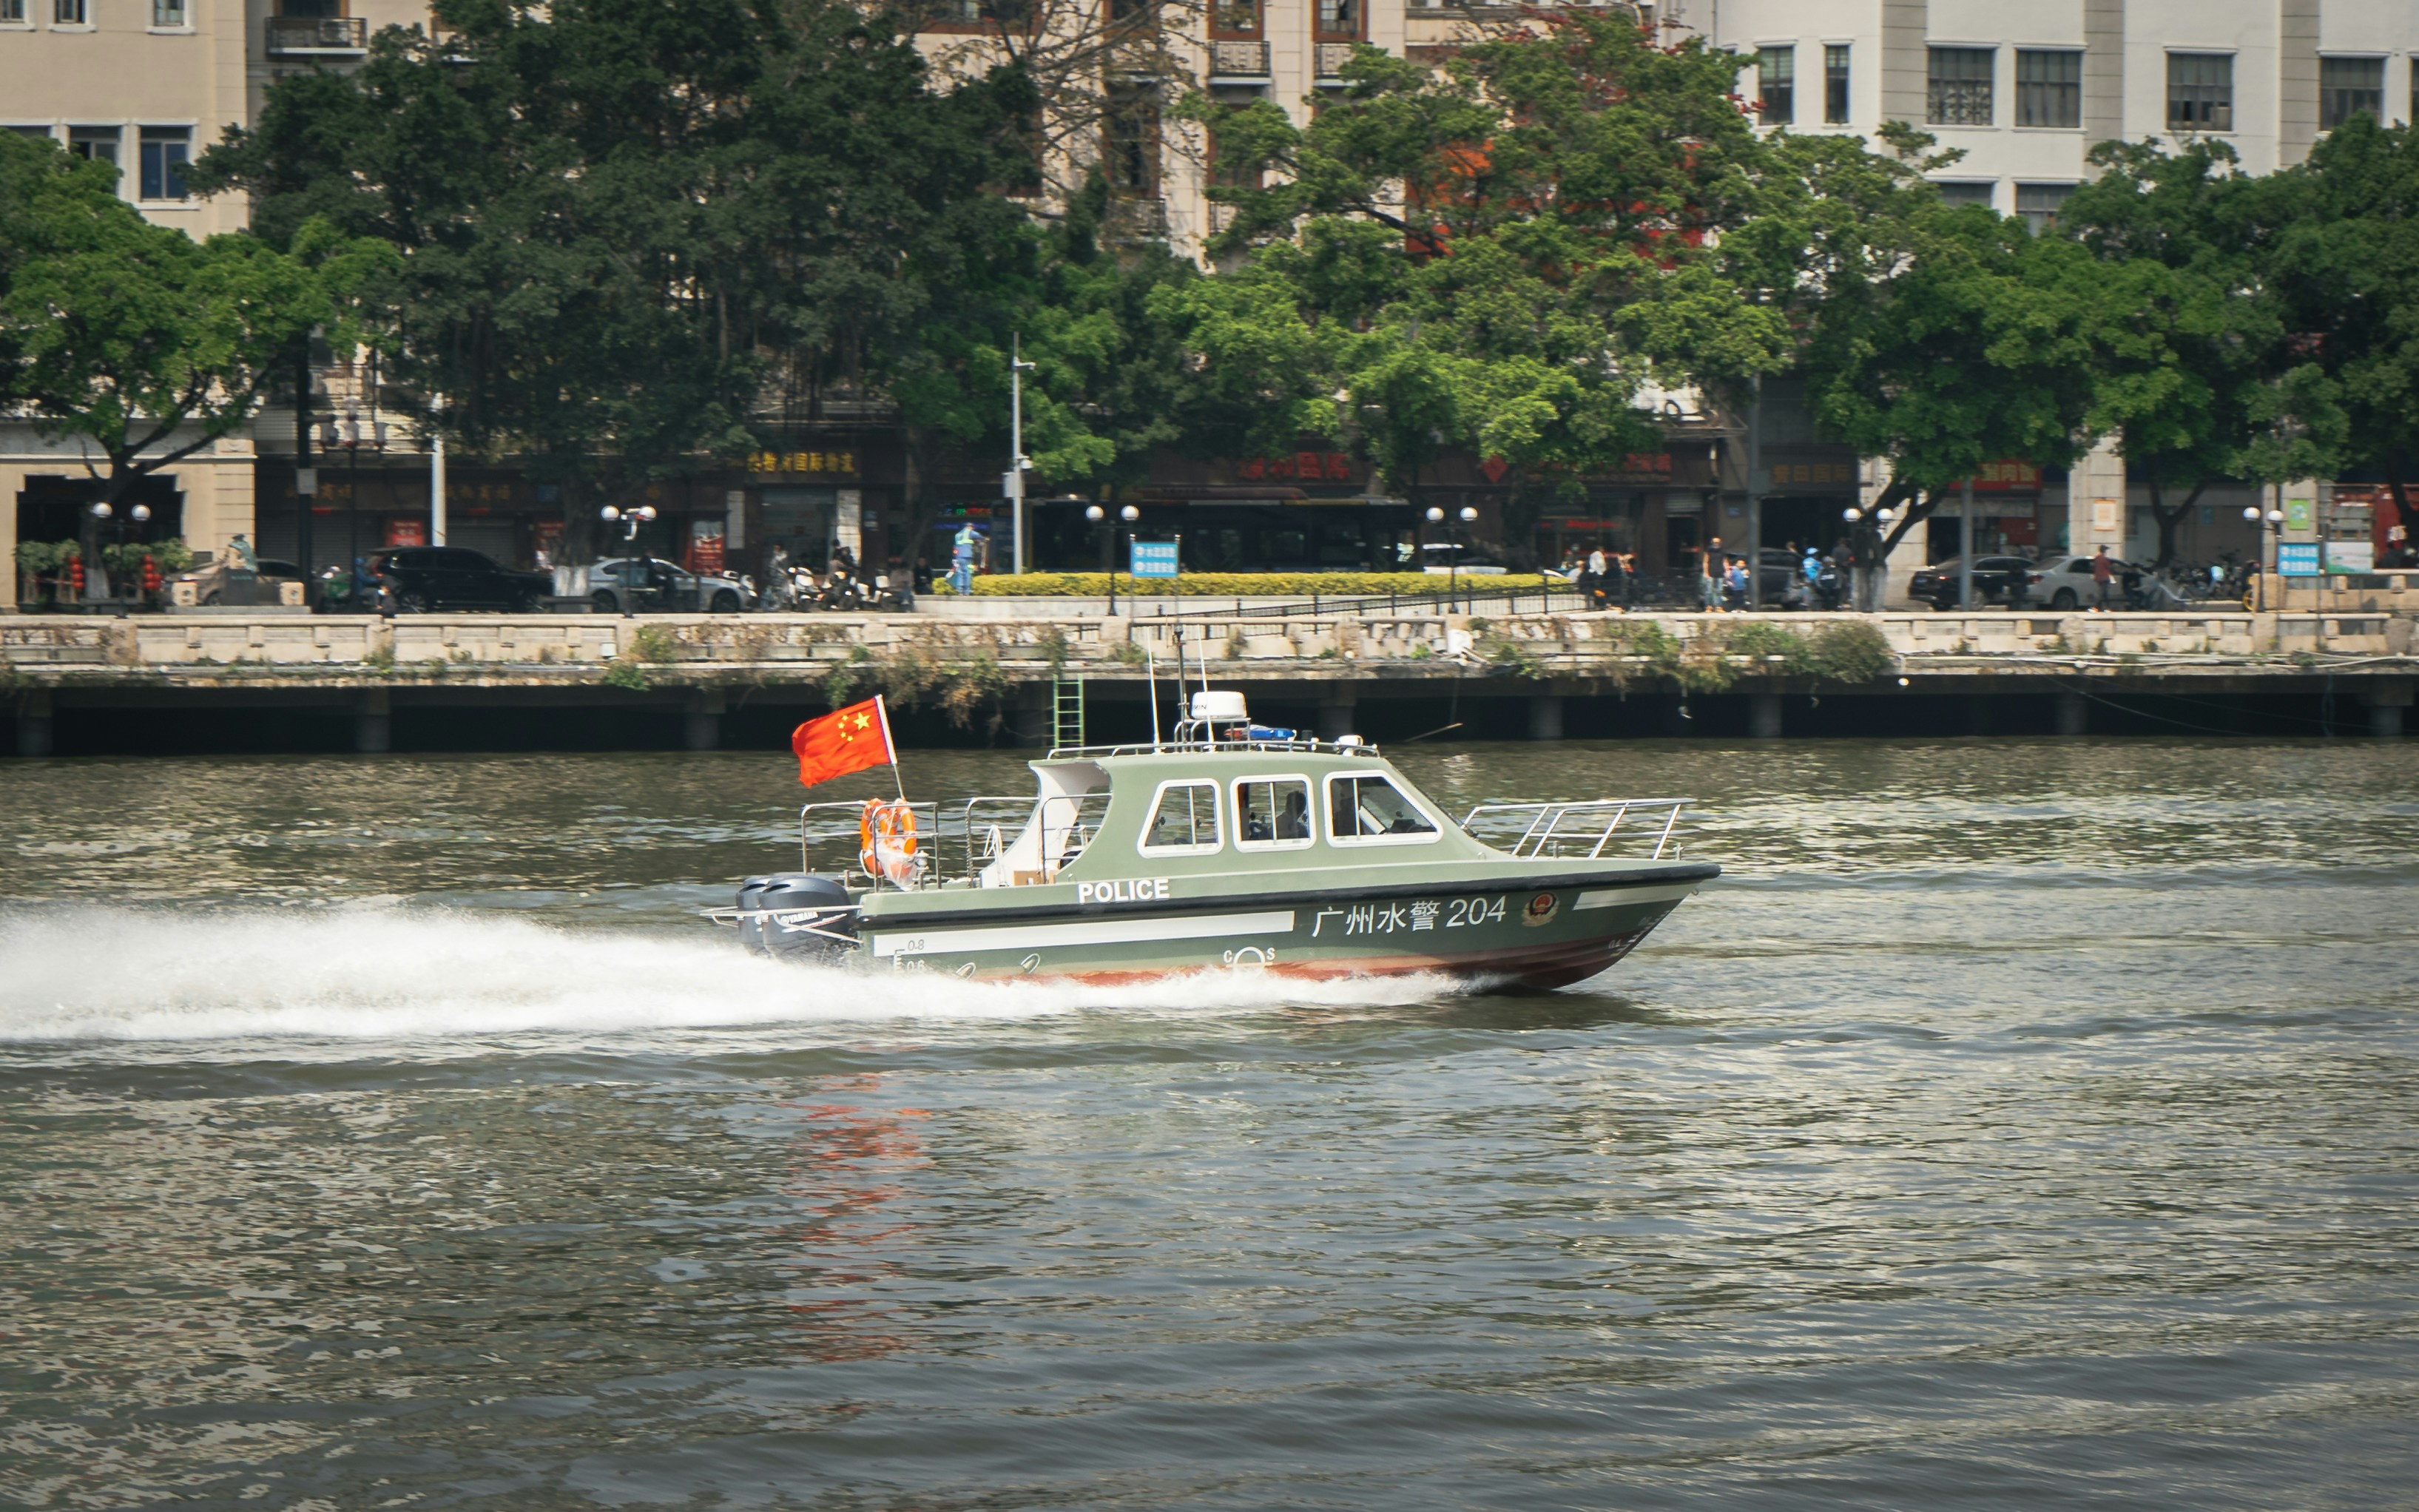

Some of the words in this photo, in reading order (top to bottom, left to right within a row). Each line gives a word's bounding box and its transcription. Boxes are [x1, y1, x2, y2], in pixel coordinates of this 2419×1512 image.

[1078, 878, 1170, 904] POLICE
[789, 911, 819, 924] YAMAHA
[1312, 900, 1441, 937] 广州水警
[1446, 895, 1507, 928] 204
[907, 939, 925, 951] 0.8
